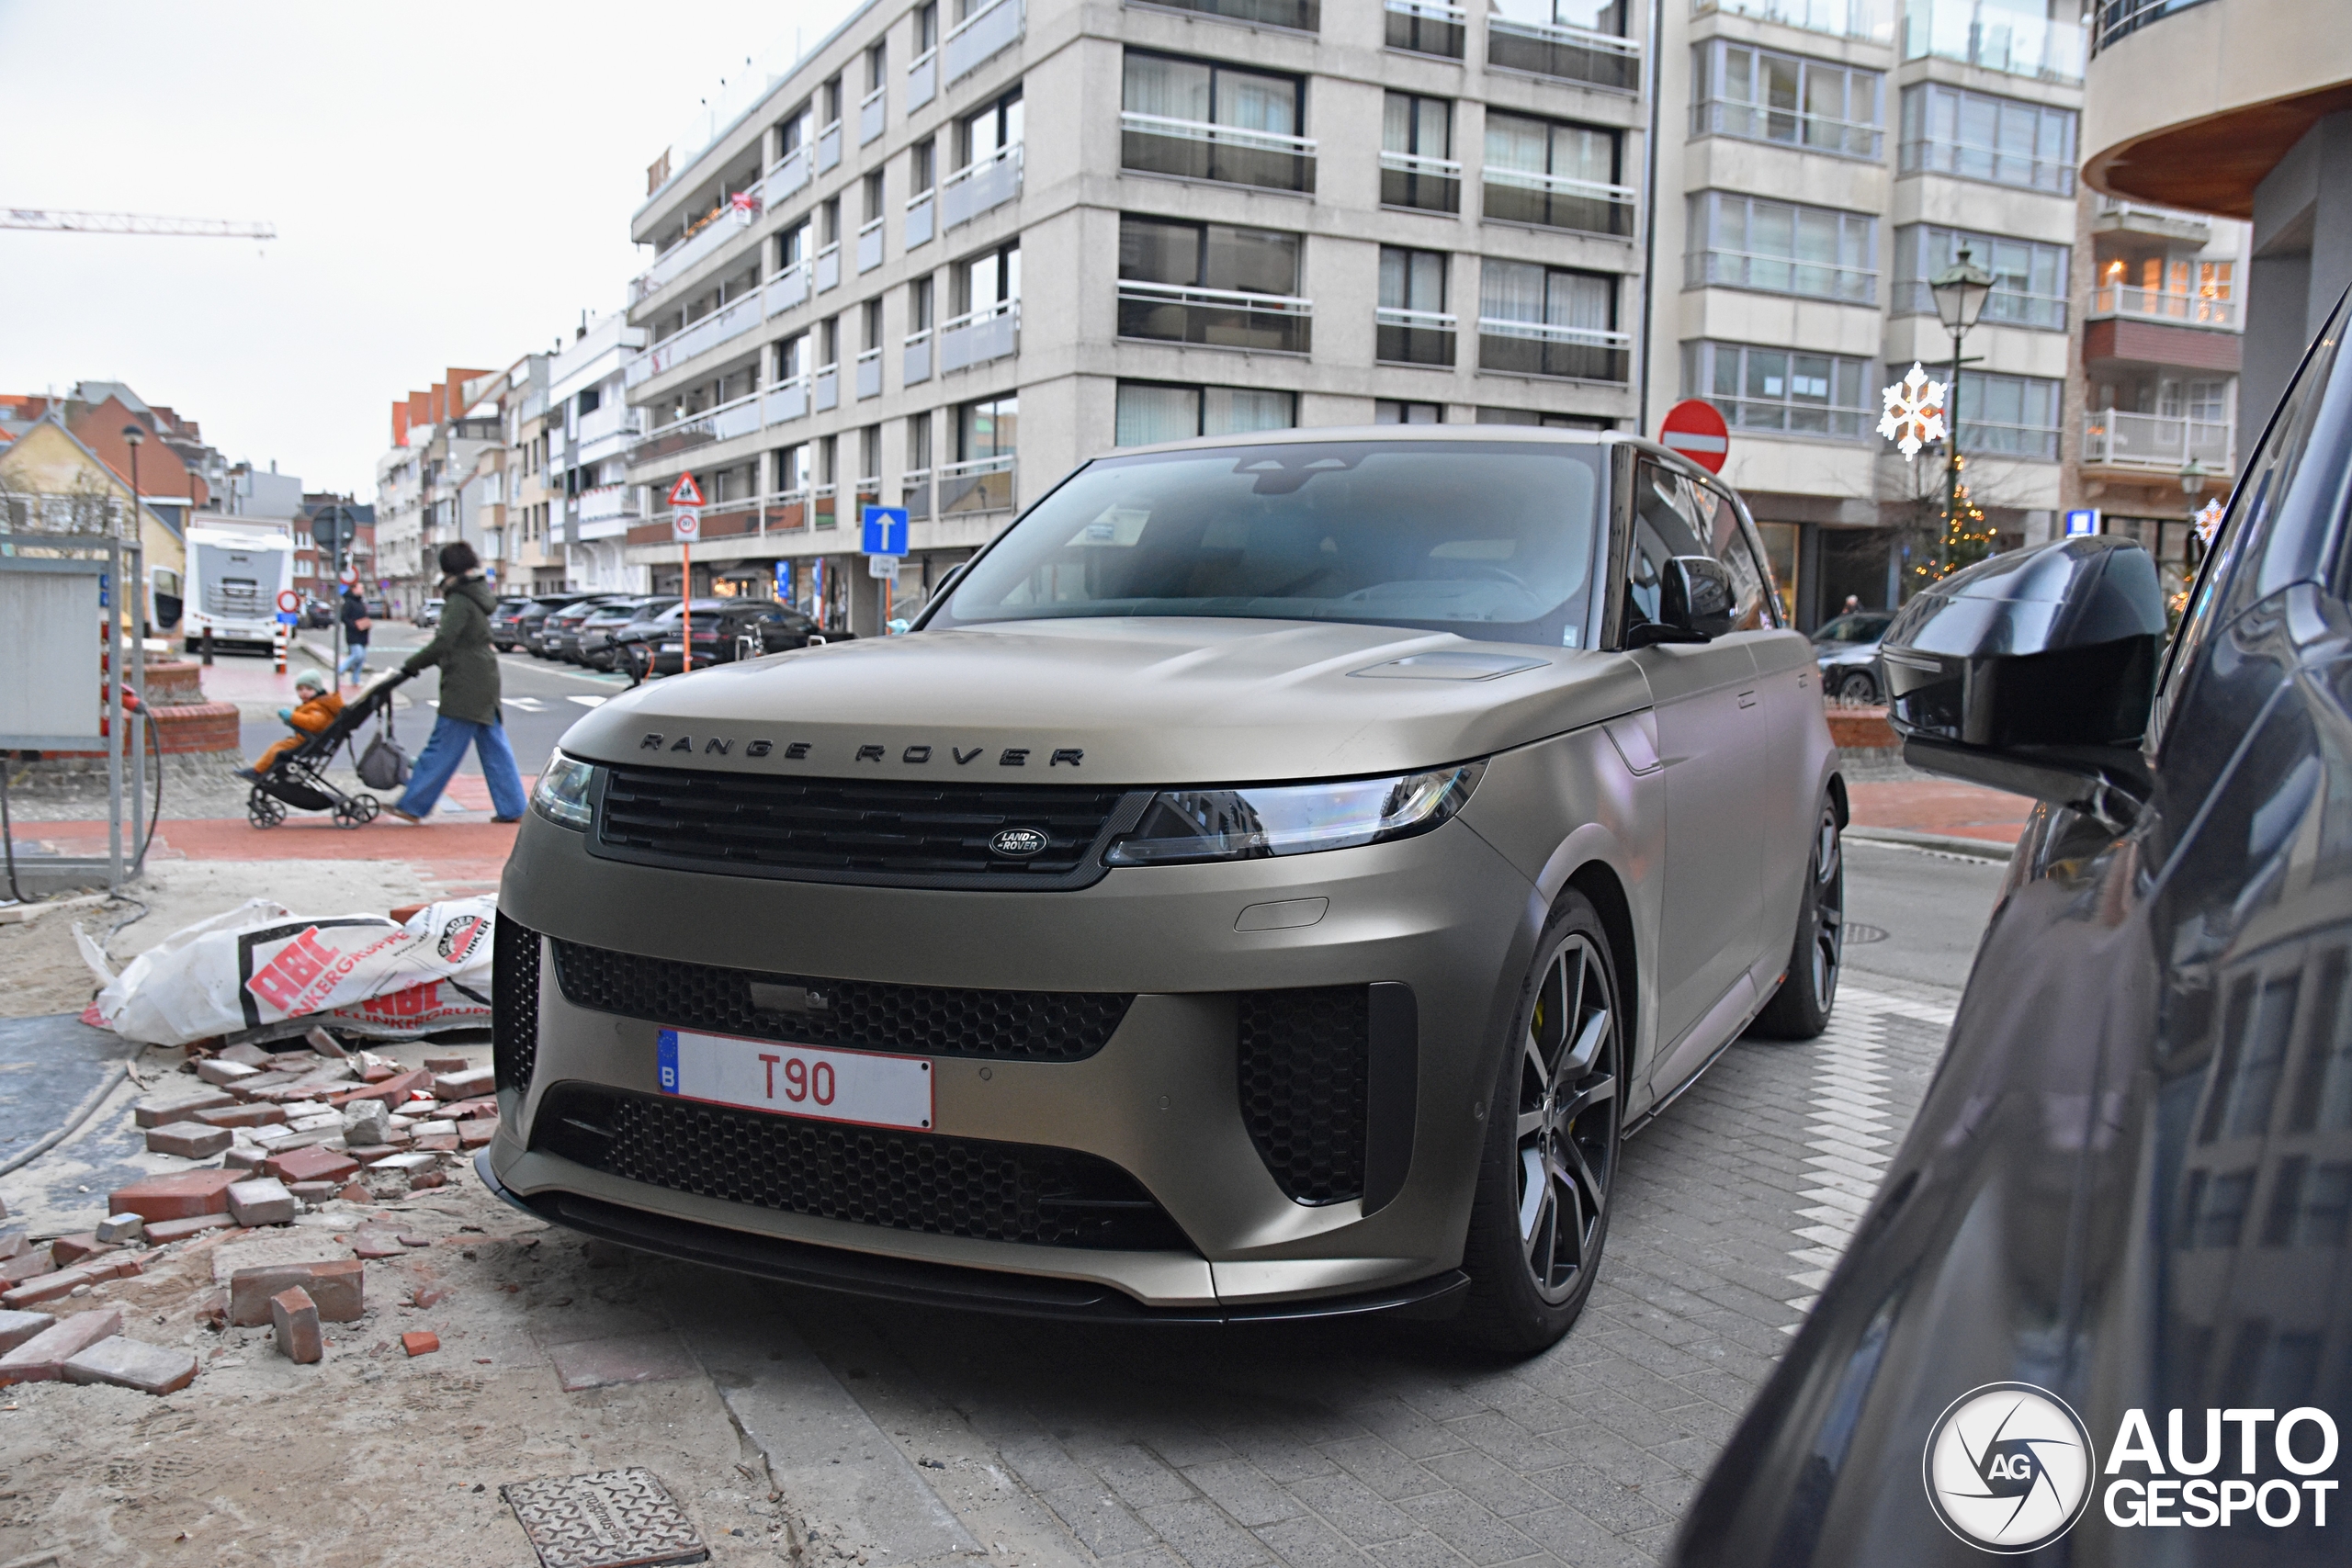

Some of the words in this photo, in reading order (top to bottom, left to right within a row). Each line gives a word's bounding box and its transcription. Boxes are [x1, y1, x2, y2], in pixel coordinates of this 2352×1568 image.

[641, 733, 812, 760] RANGE
[856, 744, 1084, 767] ROVER
[1001, 832, 1030, 841] LAND
[1003, 841, 1037, 850] ROVER
[247, 926, 341, 1012] ABC
[662, 1066, 675, 1088] B
[758, 1054, 836, 1106] T90
